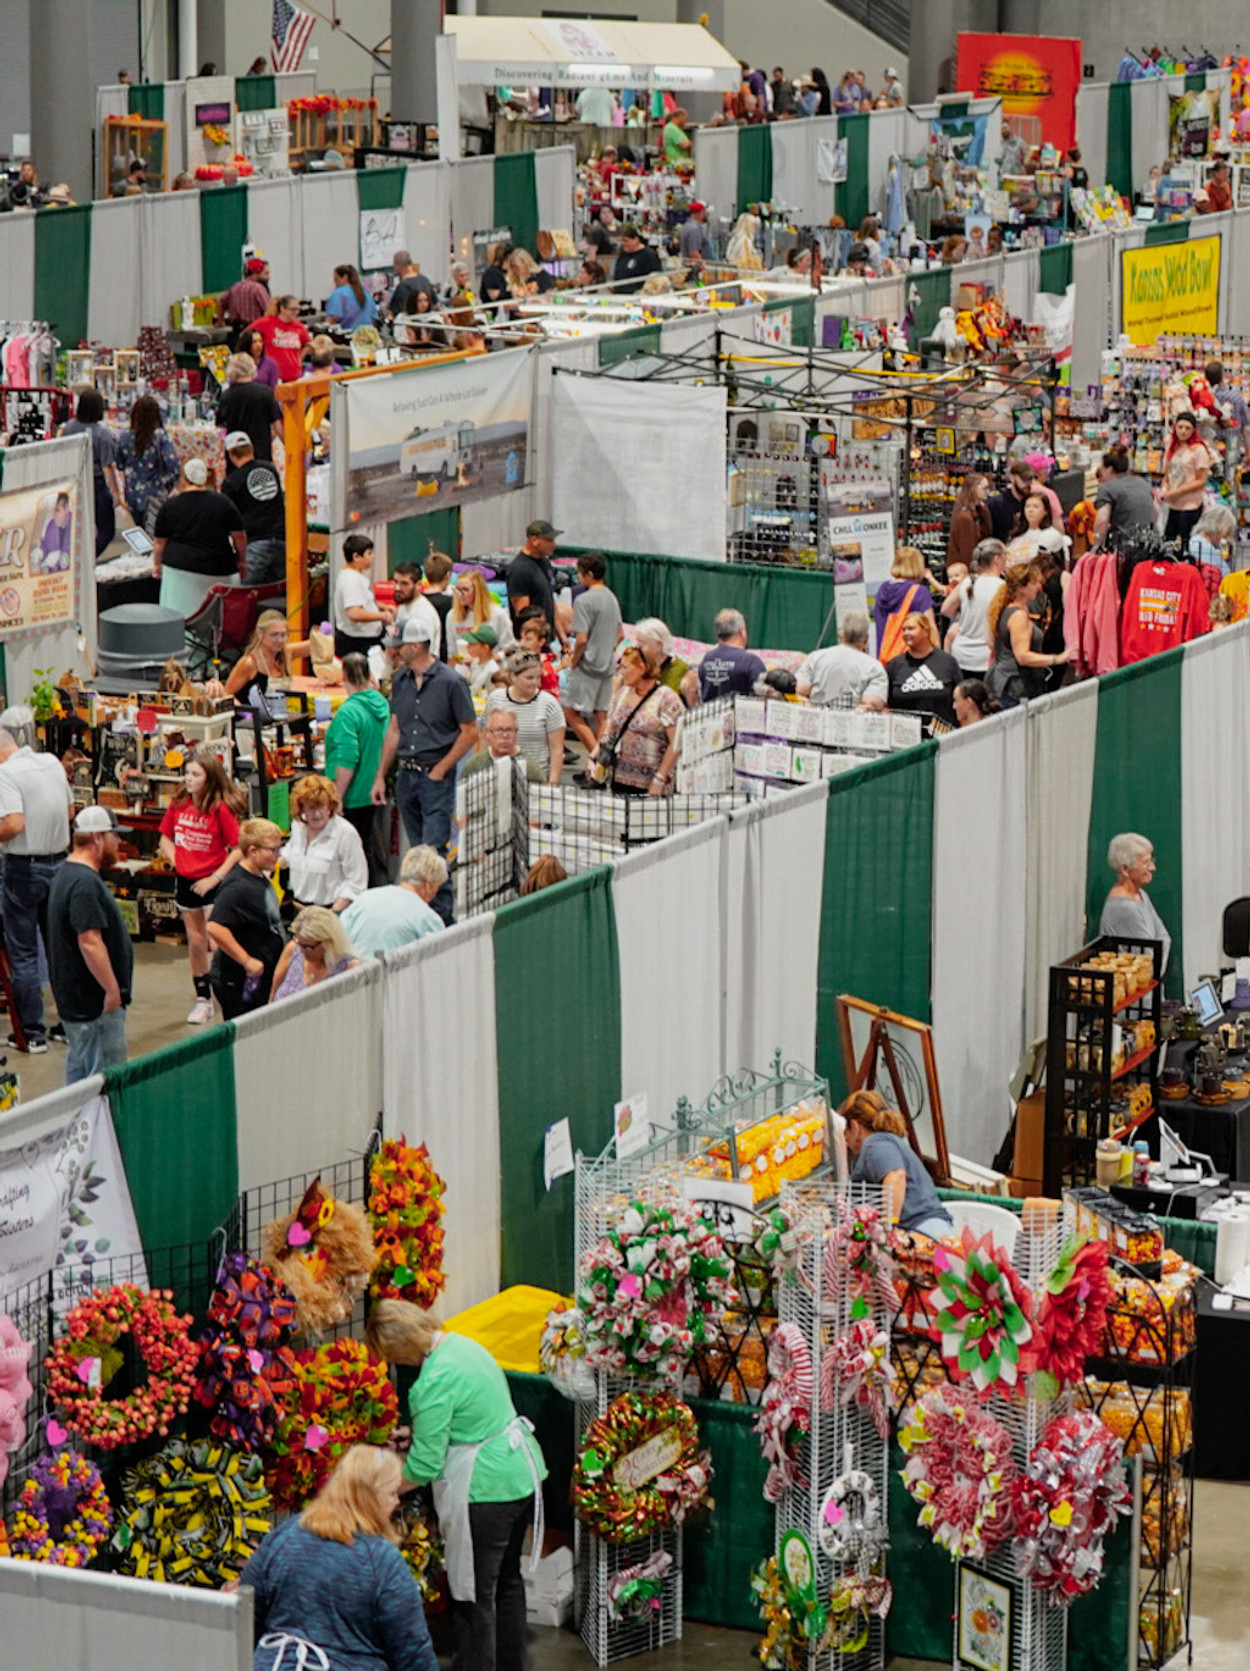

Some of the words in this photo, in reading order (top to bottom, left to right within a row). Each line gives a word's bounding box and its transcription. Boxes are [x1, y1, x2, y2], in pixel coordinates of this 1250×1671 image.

[494, 67, 553, 82] Discovering
[557, 69, 595, 82] Radiant
[1130, 261, 1165, 304] Kansas
[1189, 245, 1214, 294] Bowl
[901, 680, 945, 693] adidas
